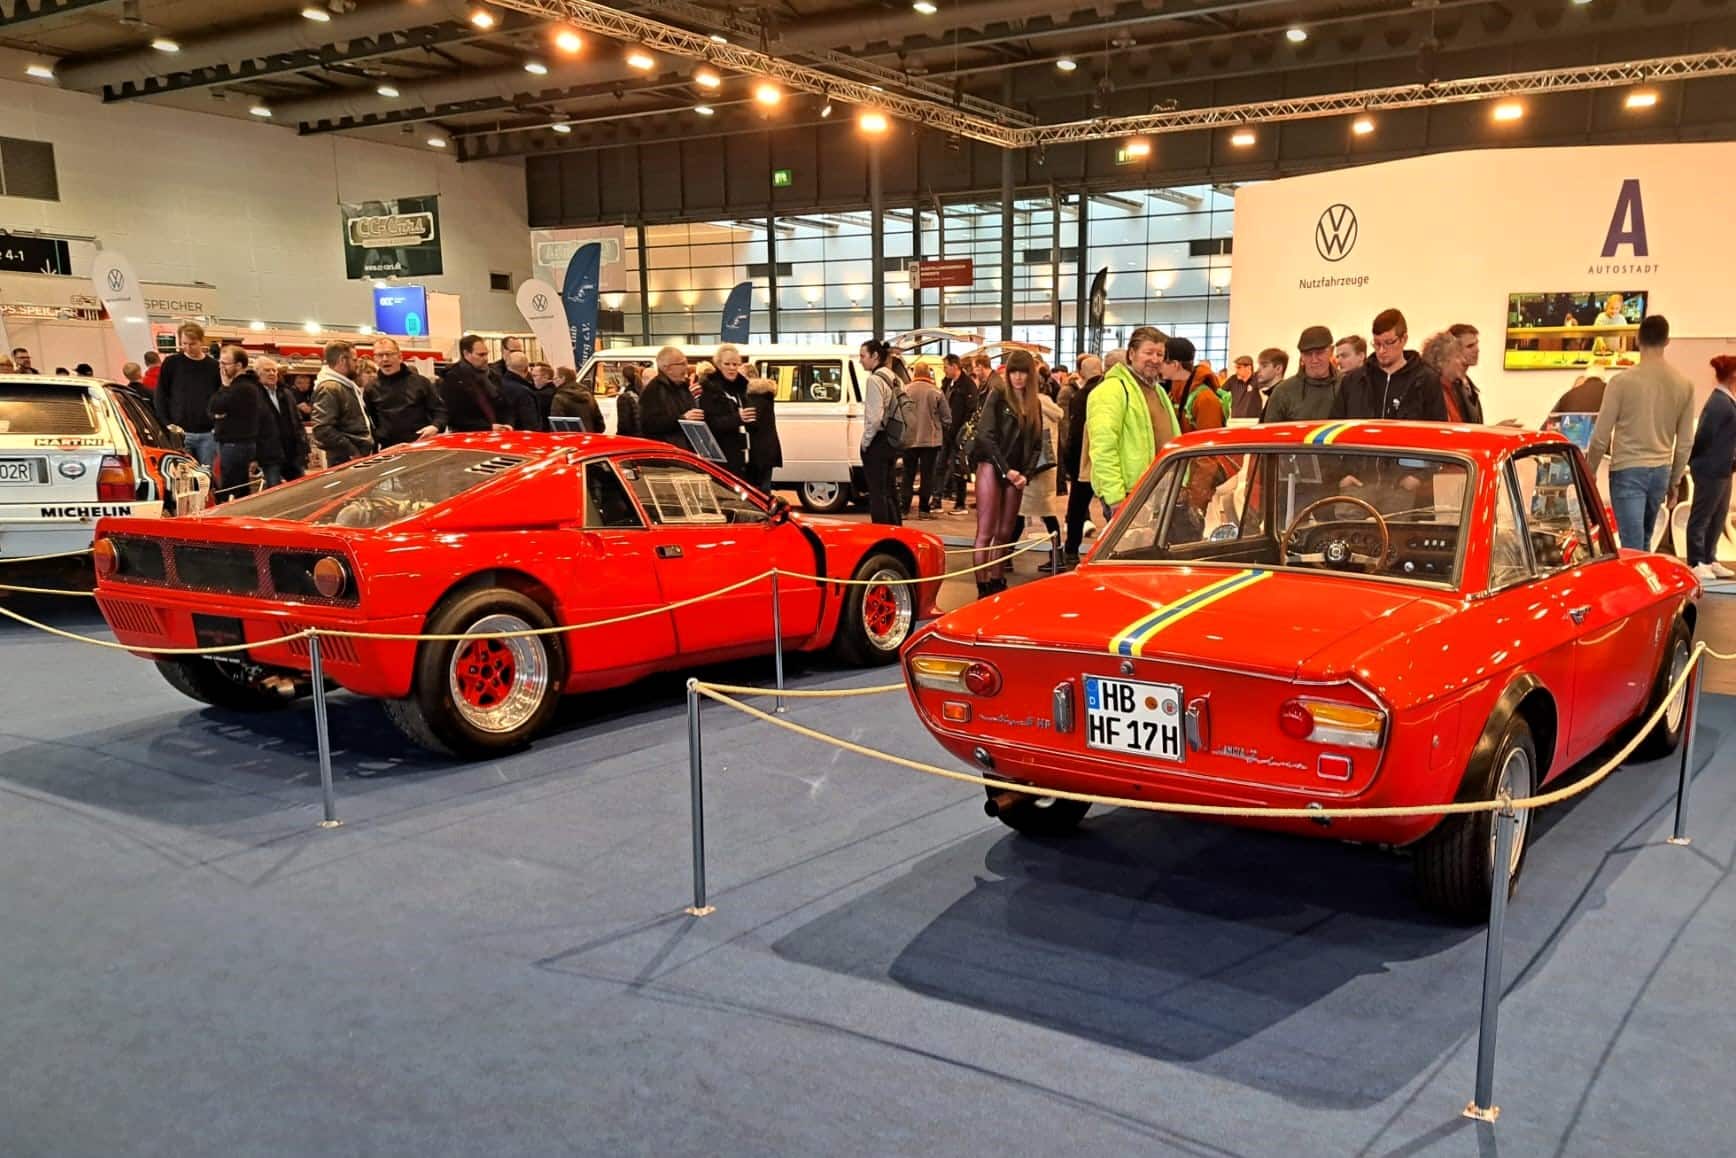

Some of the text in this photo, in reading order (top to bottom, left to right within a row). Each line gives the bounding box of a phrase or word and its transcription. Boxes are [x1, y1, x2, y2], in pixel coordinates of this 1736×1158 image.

[1600, 178, 1649, 258] A
[1587, 264, 1660, 275] AUTOSTADT
[1298, 275, 1370, 289] Nutzfahrzeuge
[40, 505, 132, 518] MICHELIN
[1102, 681, 1136, 713] HB
[1089, 714, 1122, 745] HF
